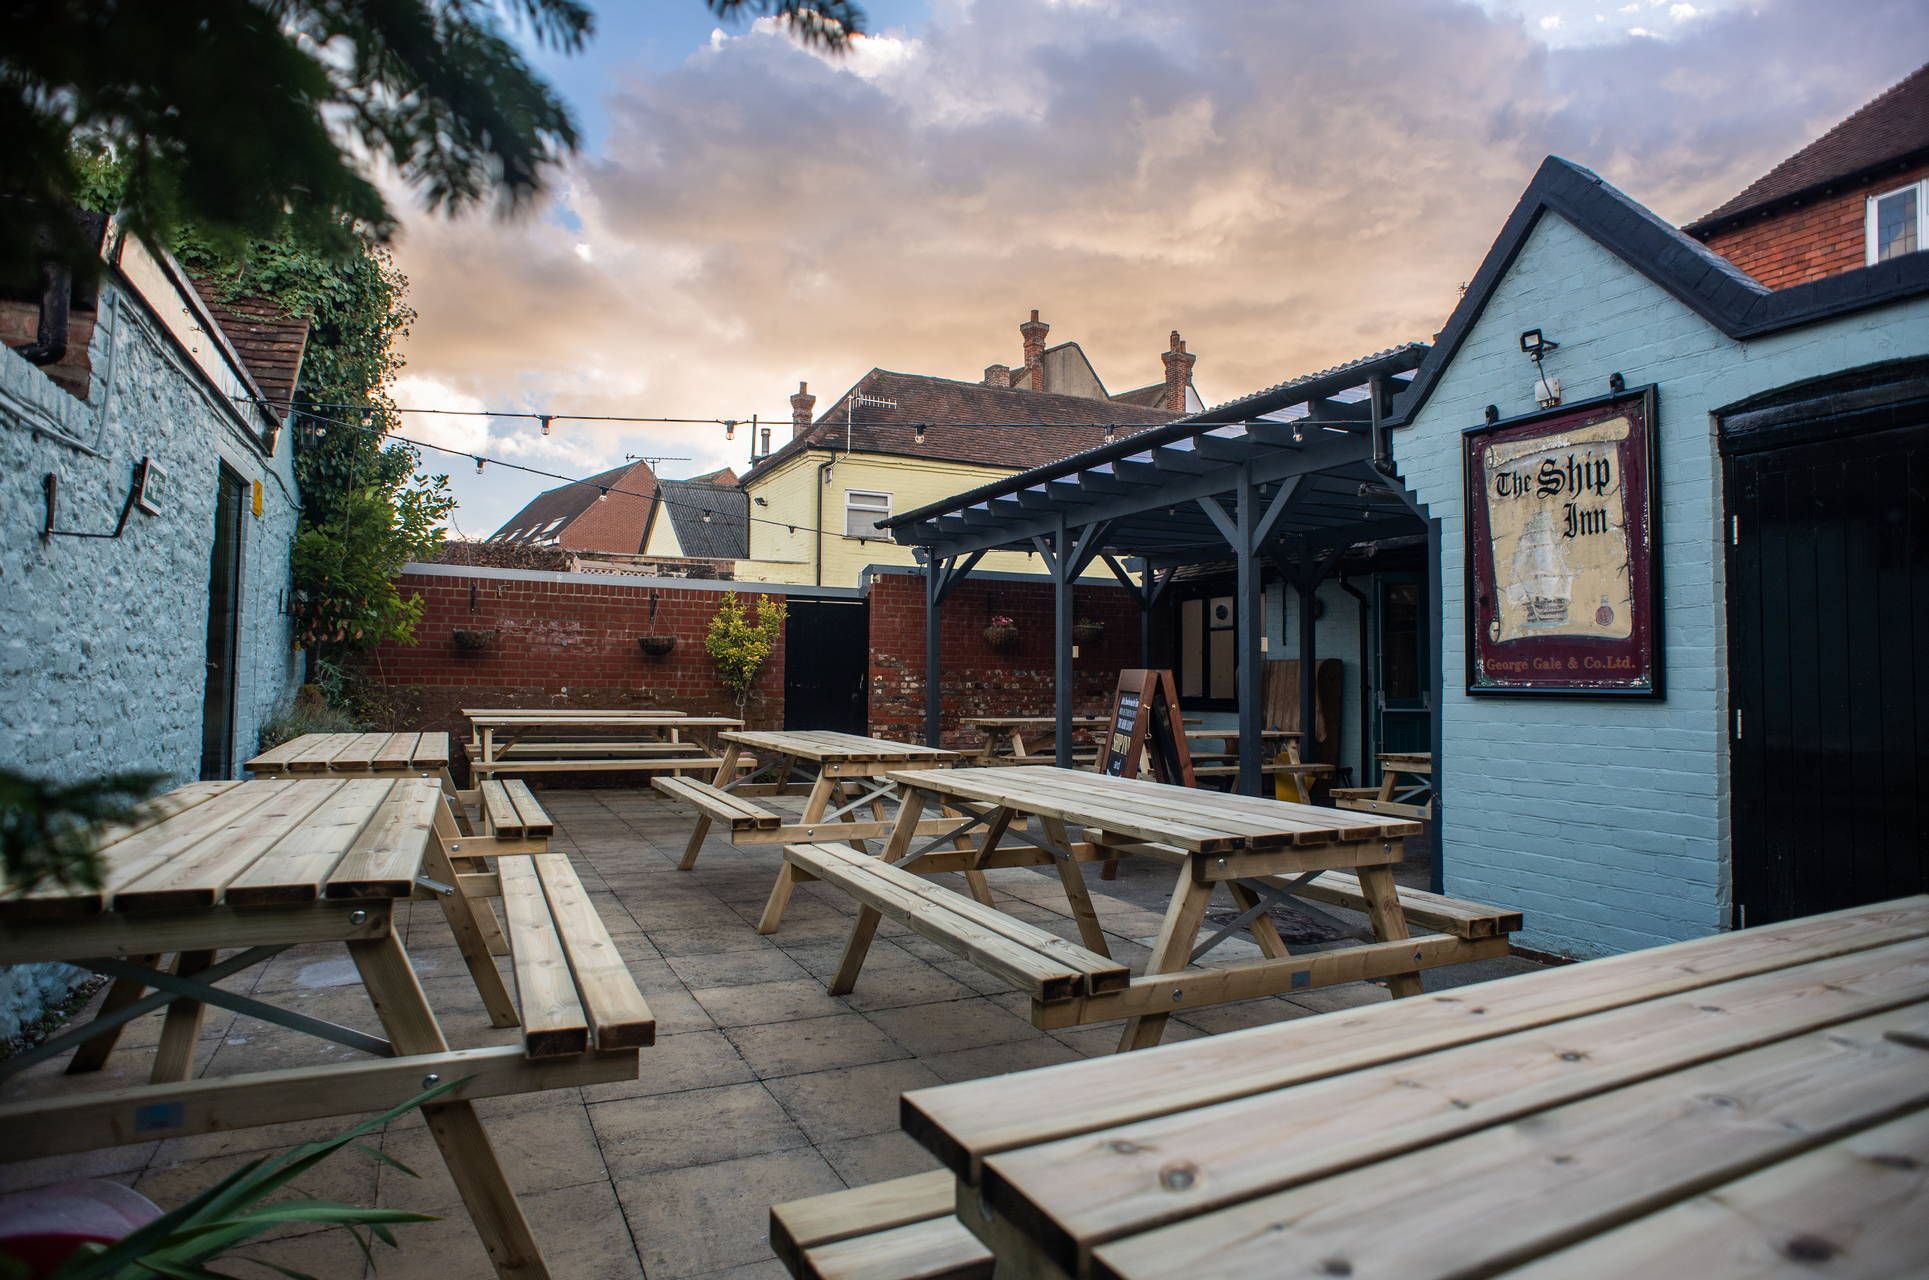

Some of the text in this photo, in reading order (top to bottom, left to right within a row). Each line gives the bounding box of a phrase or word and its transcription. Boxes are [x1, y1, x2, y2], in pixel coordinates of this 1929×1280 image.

[1495, 450, 1610, 500] The Ship
[1563, 502, 1607, 539] Inn
[1486, 658, 1529, 672] George
[1532, 657, 1562, 670] Gale
[1567, 656, 1578, 669] &
